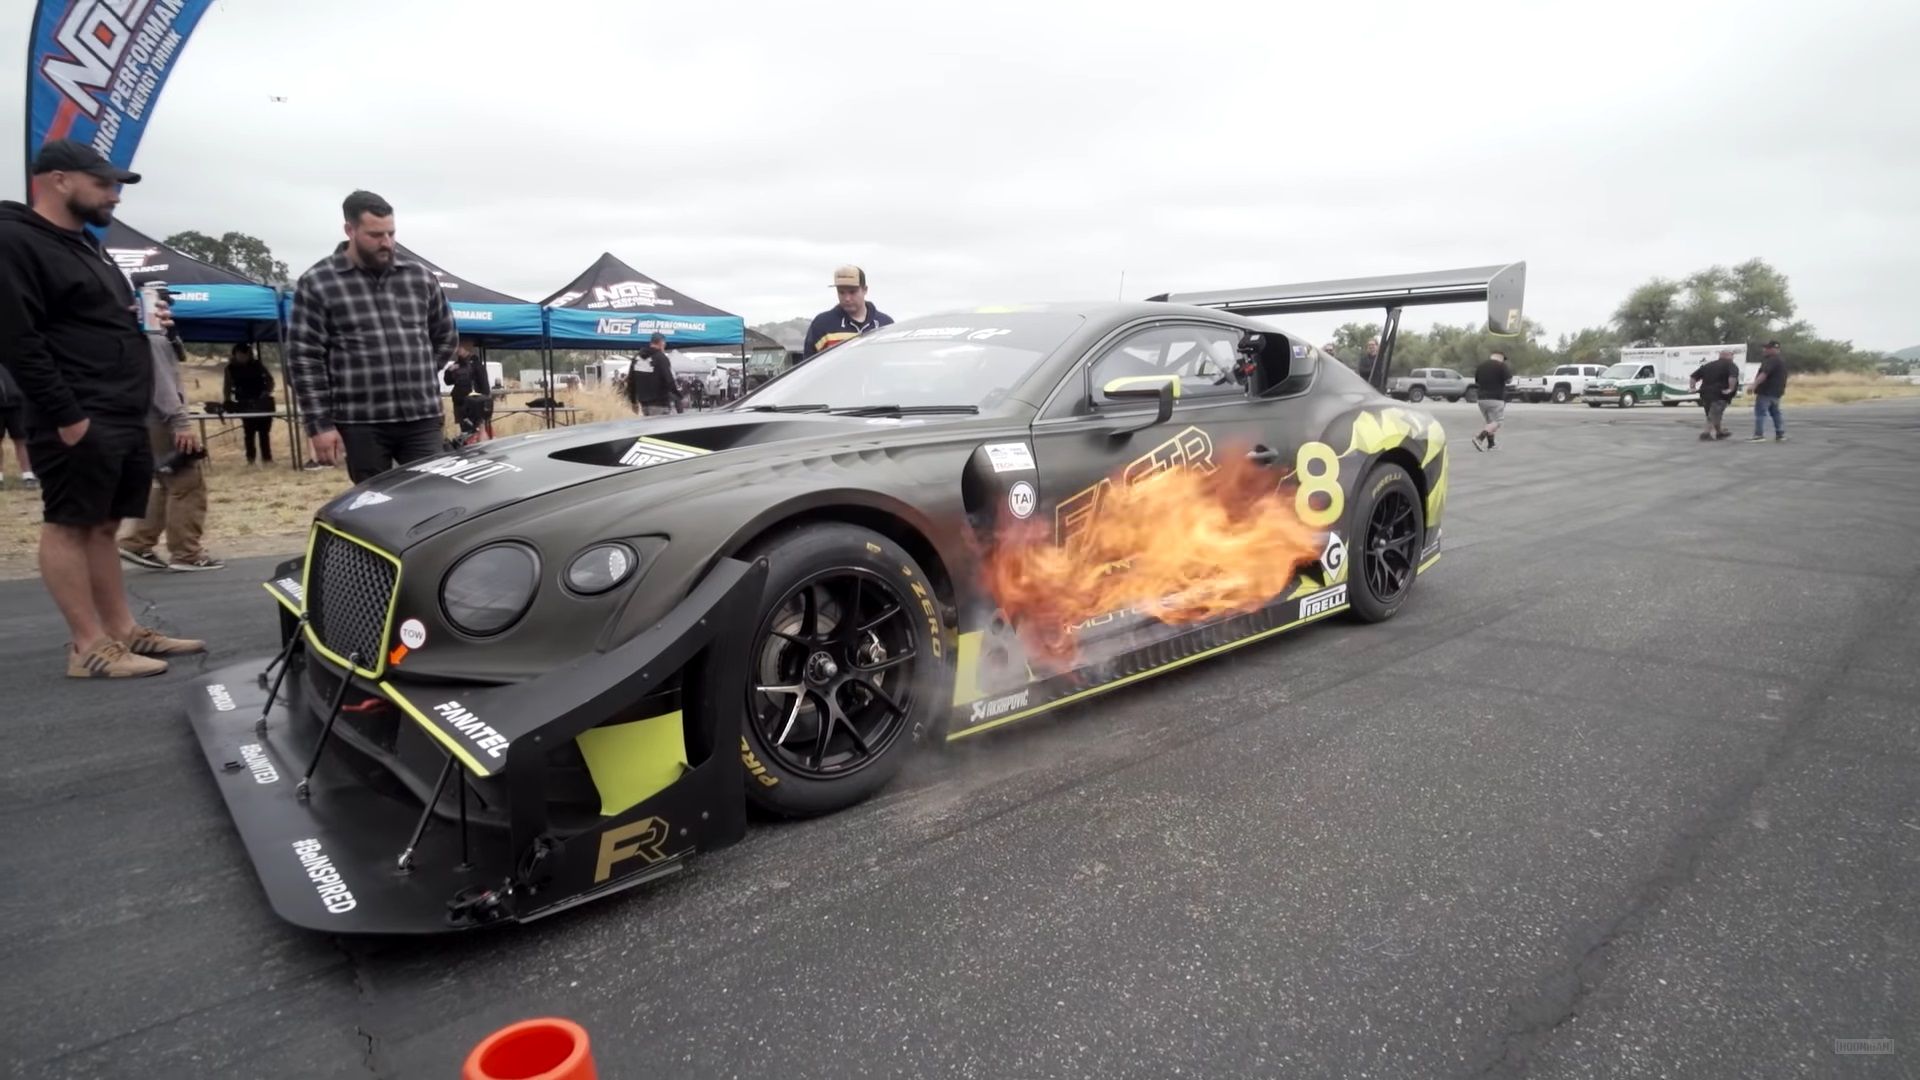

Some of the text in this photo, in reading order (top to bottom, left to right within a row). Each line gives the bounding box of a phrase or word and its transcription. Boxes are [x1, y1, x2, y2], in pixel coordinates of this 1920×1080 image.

[126, 29, 182, 120] ENERGY DRINK
[92, 105, 122, 162] HIGH
[594, 282, 659, 302] NOS
[597, 318, 637, 335] NOS
[656, 320, 706, 332] PERFORMANCE
[1295, 441, 1345, 528] 8
[1326, 542, 1341, 570] G
[911, 581, 942, 658] ZERO
[1298, 583, 1347, 620] PIRELLI
[403, 629, 424, 640] TOW
[433, 700, 511, 758] FANATEC
[291, 838, 358, 914] #BeINSPIRED
[594, 815, 669, 883] FR
